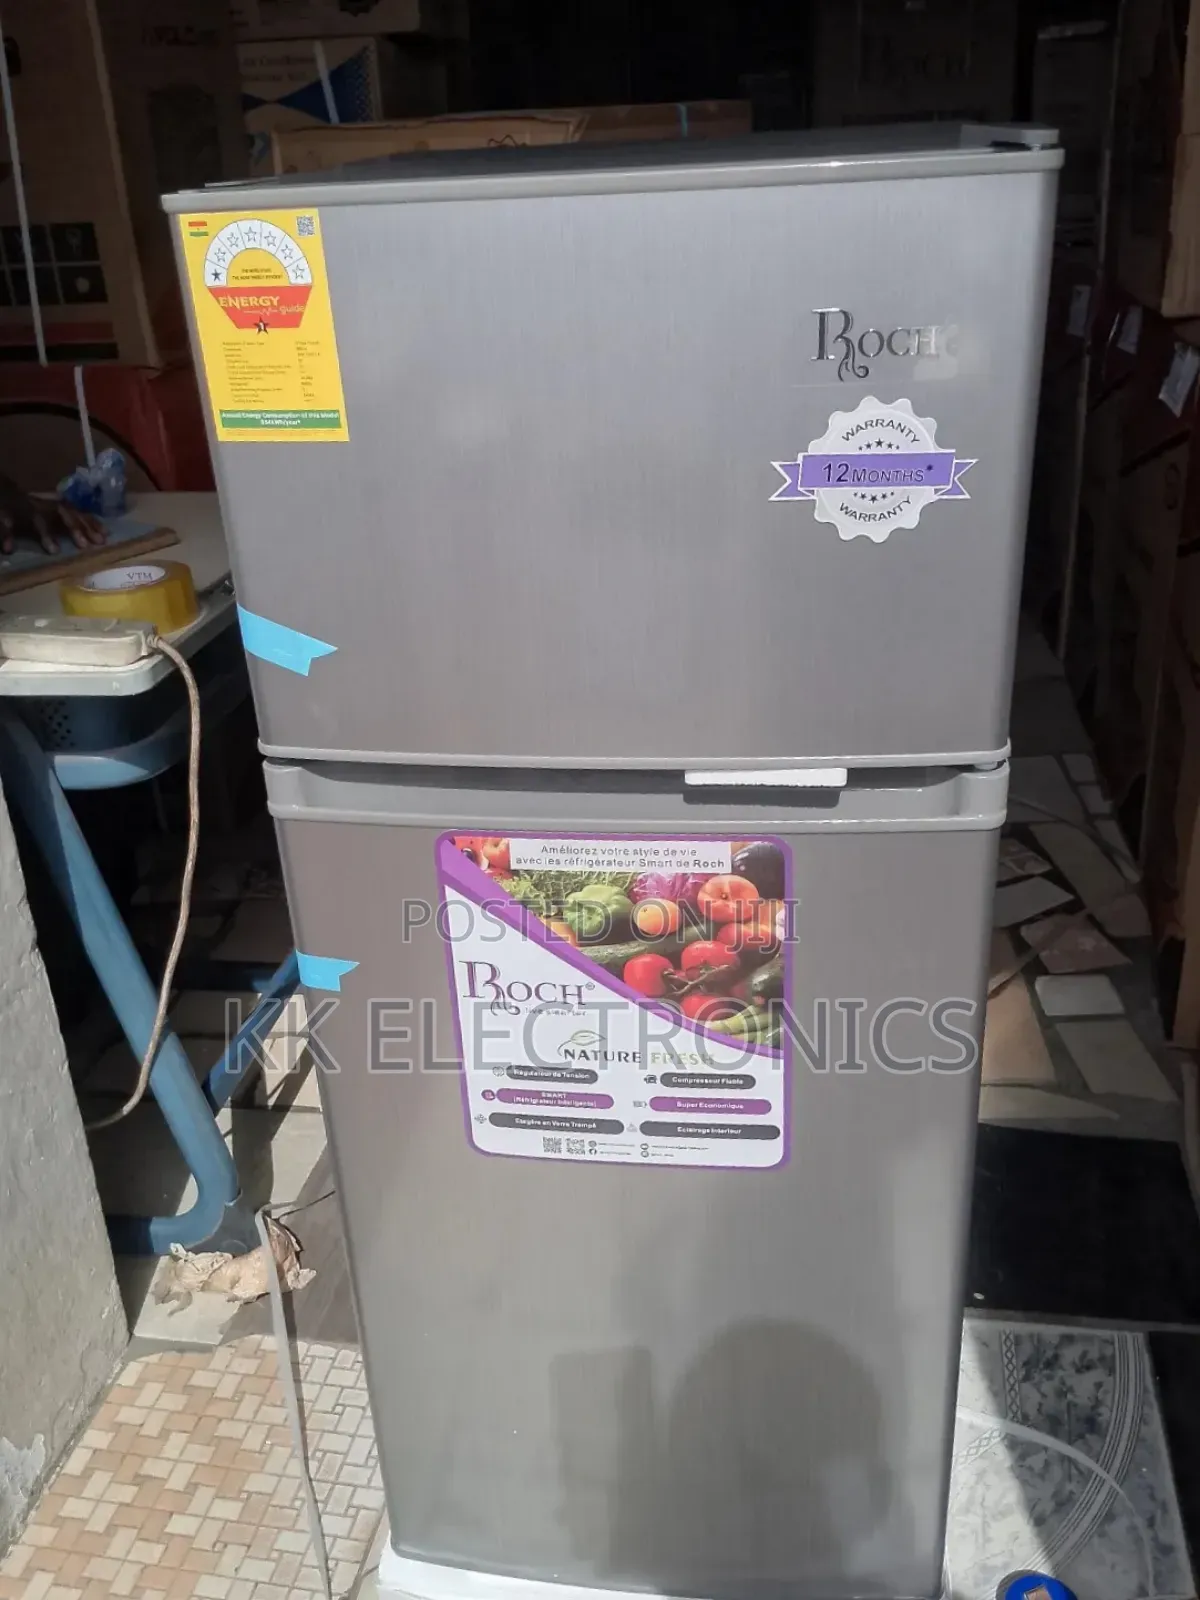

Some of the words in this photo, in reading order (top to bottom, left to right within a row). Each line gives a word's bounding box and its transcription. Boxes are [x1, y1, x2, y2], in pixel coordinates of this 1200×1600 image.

[219, 294, 280, 310] ENERGY
[841, 418, 920, 444] WARRANTY
[839, 495, 912, 523] WARRANTY
[126, 572, 153, 581] VTM
[541, 845, 598, 856] Améliorez
[600, 847, 630, 857] votre
[633, 847, 660, 859] style
[663, 847, 677, 857] de
[680, 847, 697, 857] vie
[515, 857, 542, 866] avec
[544, 856, 561, 866] les
[638, 858, 673, 869] Smart
[675, 858, 690, 869] de
[693, 859, 725, 869] Roch
[564, 1049, 642, 1063] NATURE
[651, 1052, 715, 1065] FRESH
[672, 1076, 720, 1085] Compresseur
[676, 1101, 698, 1109] Super
